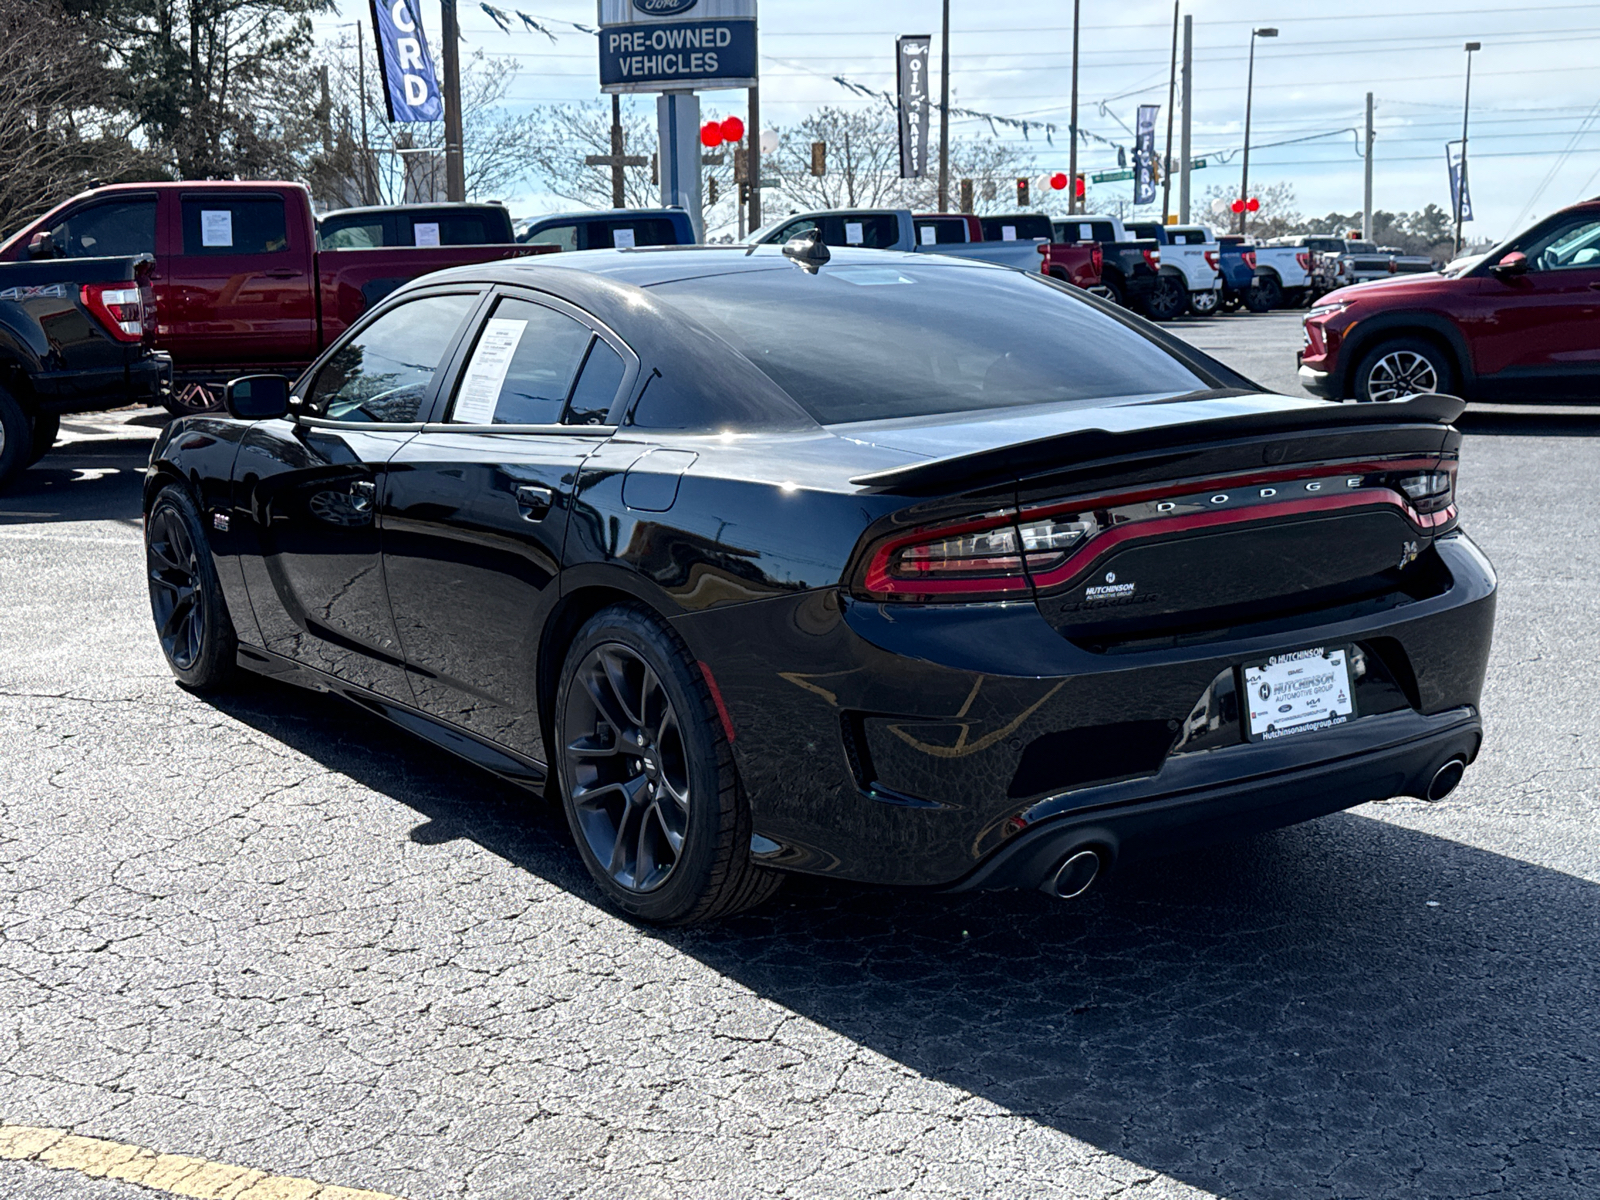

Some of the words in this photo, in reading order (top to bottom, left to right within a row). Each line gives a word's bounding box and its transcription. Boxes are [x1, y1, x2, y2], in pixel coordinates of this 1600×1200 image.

[609, 27, 732, 53] PRE-OWNED
[619, 52, 719, 76] VEHICLES
[910, 59, 921, 95] OIL
[1156, 477, 1361, 512] DODGE
[1085, 583, 1135, 595] HUTCHINSON
[1277, 647, 1324, 665] HUTCHINSON
[1273, 672, 1335, 695] HUTCHINSON
[1275, 688, 1313, 702] AUTOMOTIVE
[1314, 684, 1334, 695] GROUP
[1262, 716, 1347, 740] Hutchinsonautogroup.com
